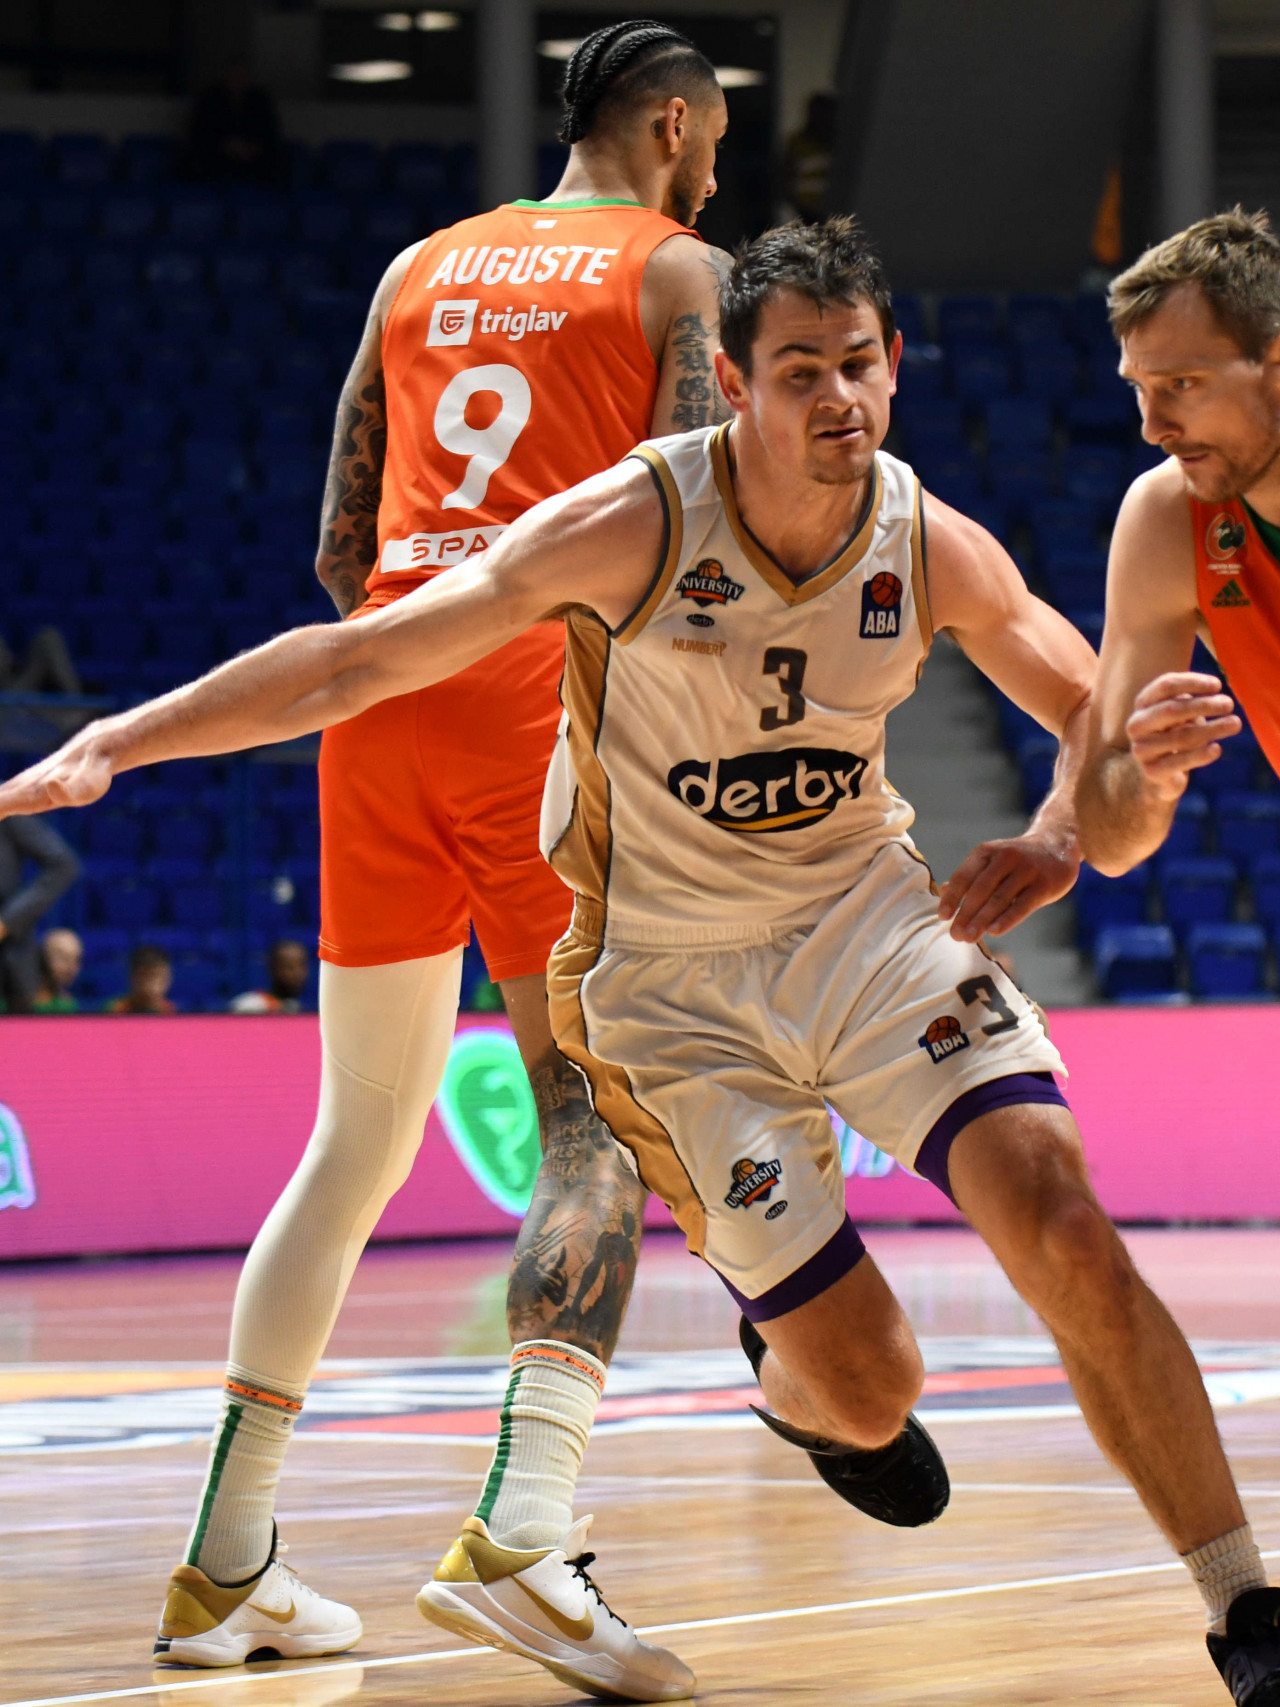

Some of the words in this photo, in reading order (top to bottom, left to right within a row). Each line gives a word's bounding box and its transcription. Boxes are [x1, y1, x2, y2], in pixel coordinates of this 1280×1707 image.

[426, 245, 619, 290] AUGUSTE
[480, 304, 569, 342] triglav
[433, 363, 532, 510] 9
[410, 530, 505, 562] SPA
[863, 610, 897, 635] ABA
[759, 646, 808, 733] 3
[678, 757, 864, 818] derby
[955, 974, 1020, 1037] 3
[726, 1160, 781, 1207] UNIVERSITY
[766, 1201, 787, 1219] derby
